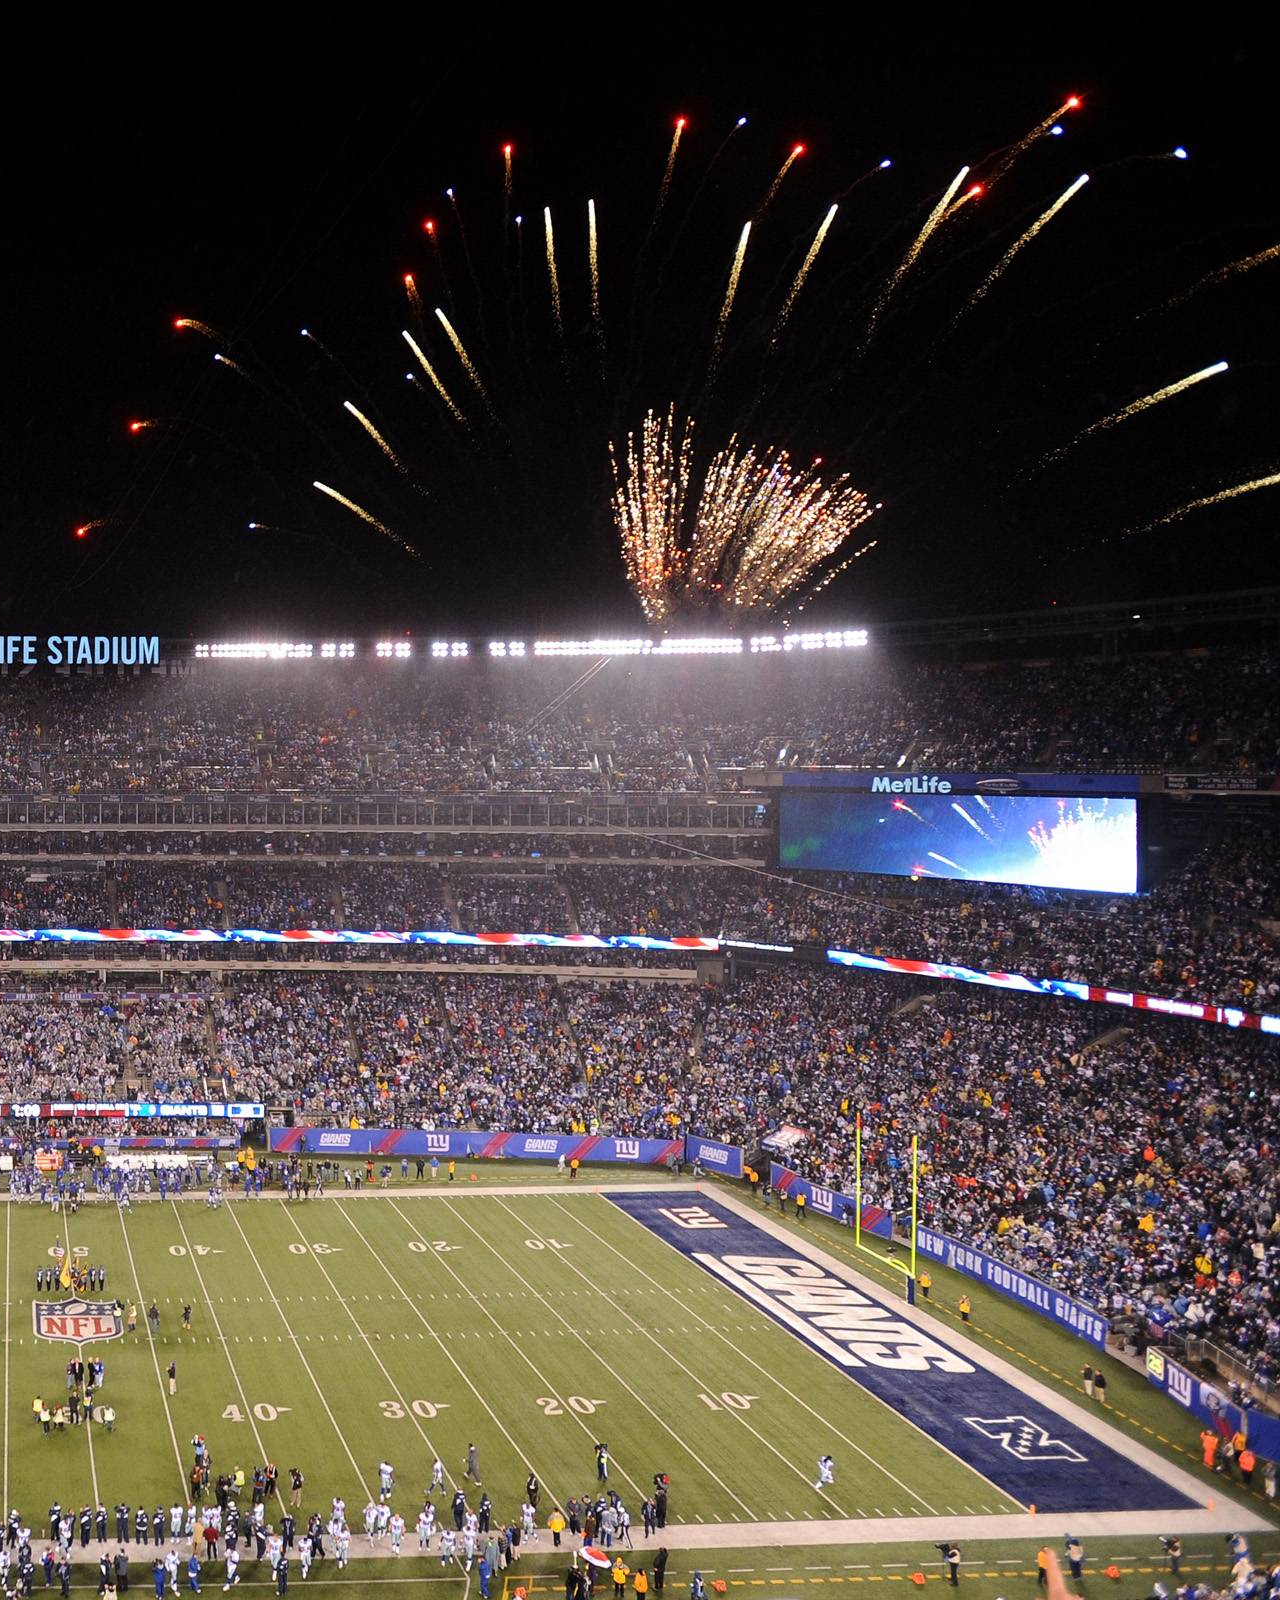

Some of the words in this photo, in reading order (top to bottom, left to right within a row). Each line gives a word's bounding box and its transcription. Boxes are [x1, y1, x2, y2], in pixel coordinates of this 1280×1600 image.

[47, 635, 160, 665] STADIUM
[872, 775, 952, 793] MetLife
[320, 1132, 352, 1145] GIANTS
[524, 1138, 559, 1151] GIANTS
[699, 1144, 729, 1163] GIANTS
[169, 1244, 211, 1257] 40
[288, 1243, 332, 1255] 30
[407, 1240, 453, 1253] 20
[524, 1238, 566, 1251] 10
[917, 1230, 944, 1256] NEW
[948, 1243, 983, 1275] YORK
[987, 1262, 1051, 1310] FOOTBALL
[1055, 1297, 1103, 1342] GIANTS
[720, 1254, 976, 1373] GIANTS
[44, 1316, 113, 1337] NFL
[378, 1399, 439, 1419] 30
[535, 1395, 597, 1416] 20
[698, 1392, 753, 1410] 10
[221, 1403, 279, 1422] 40
